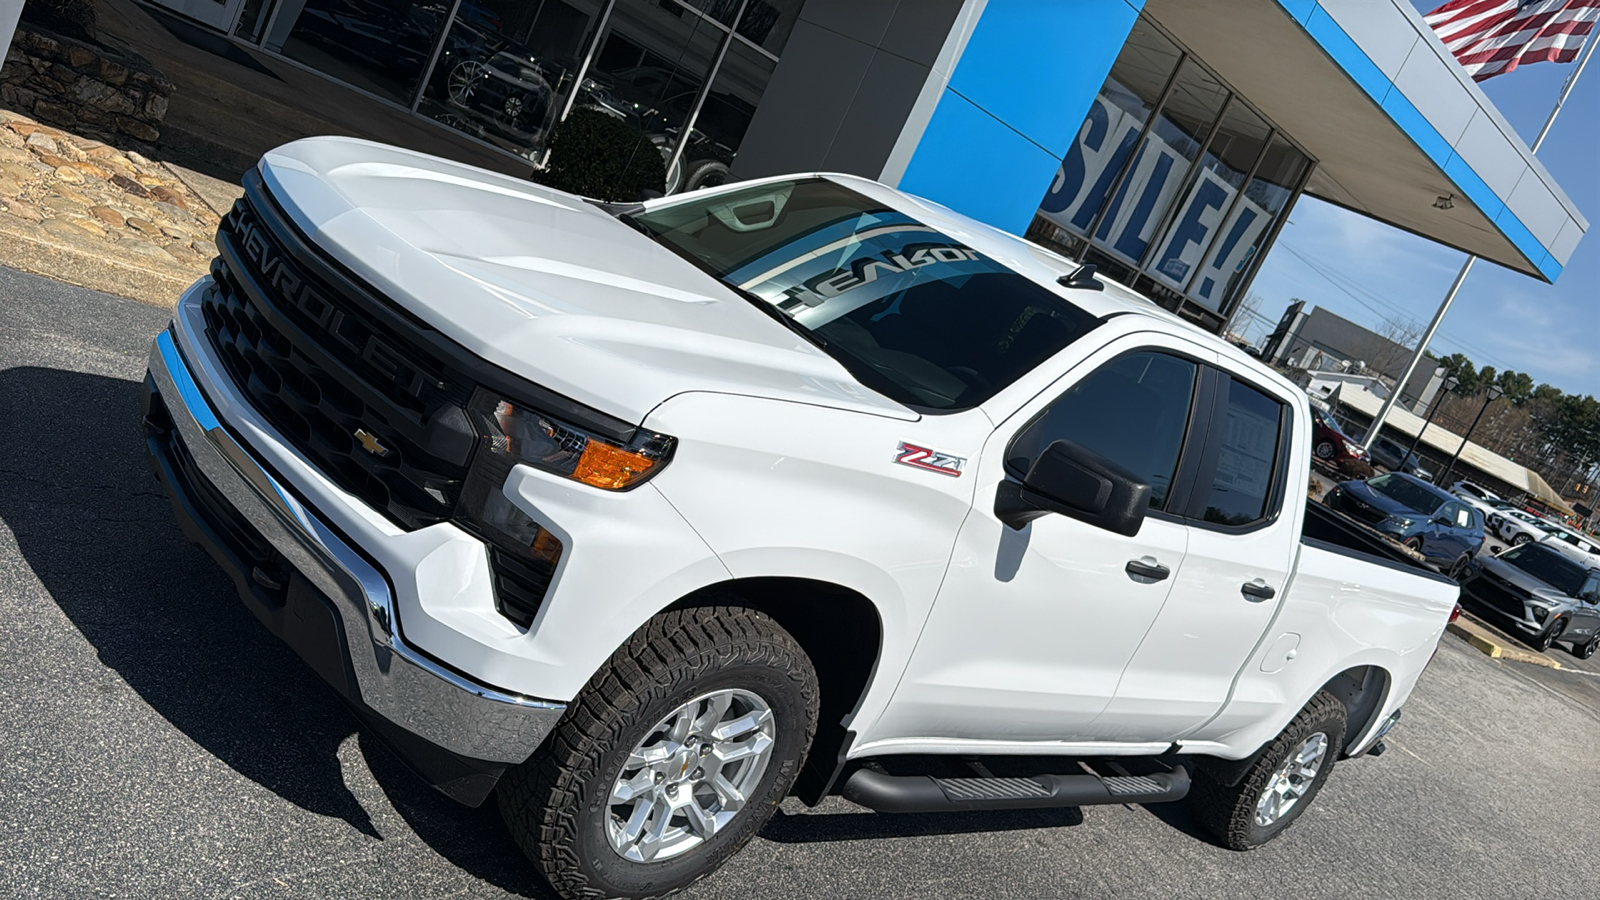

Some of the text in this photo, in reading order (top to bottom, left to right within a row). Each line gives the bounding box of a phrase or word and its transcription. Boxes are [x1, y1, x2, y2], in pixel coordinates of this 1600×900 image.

[1038, 98, 1257, 300] SALE!
[228, 200, 445, 399] CHEVROLET
[891, 440, 967, 478] Z71
[589, 687, 697, 813] GOODYEAR
[706, 759, 794, 866] WRANGLER
